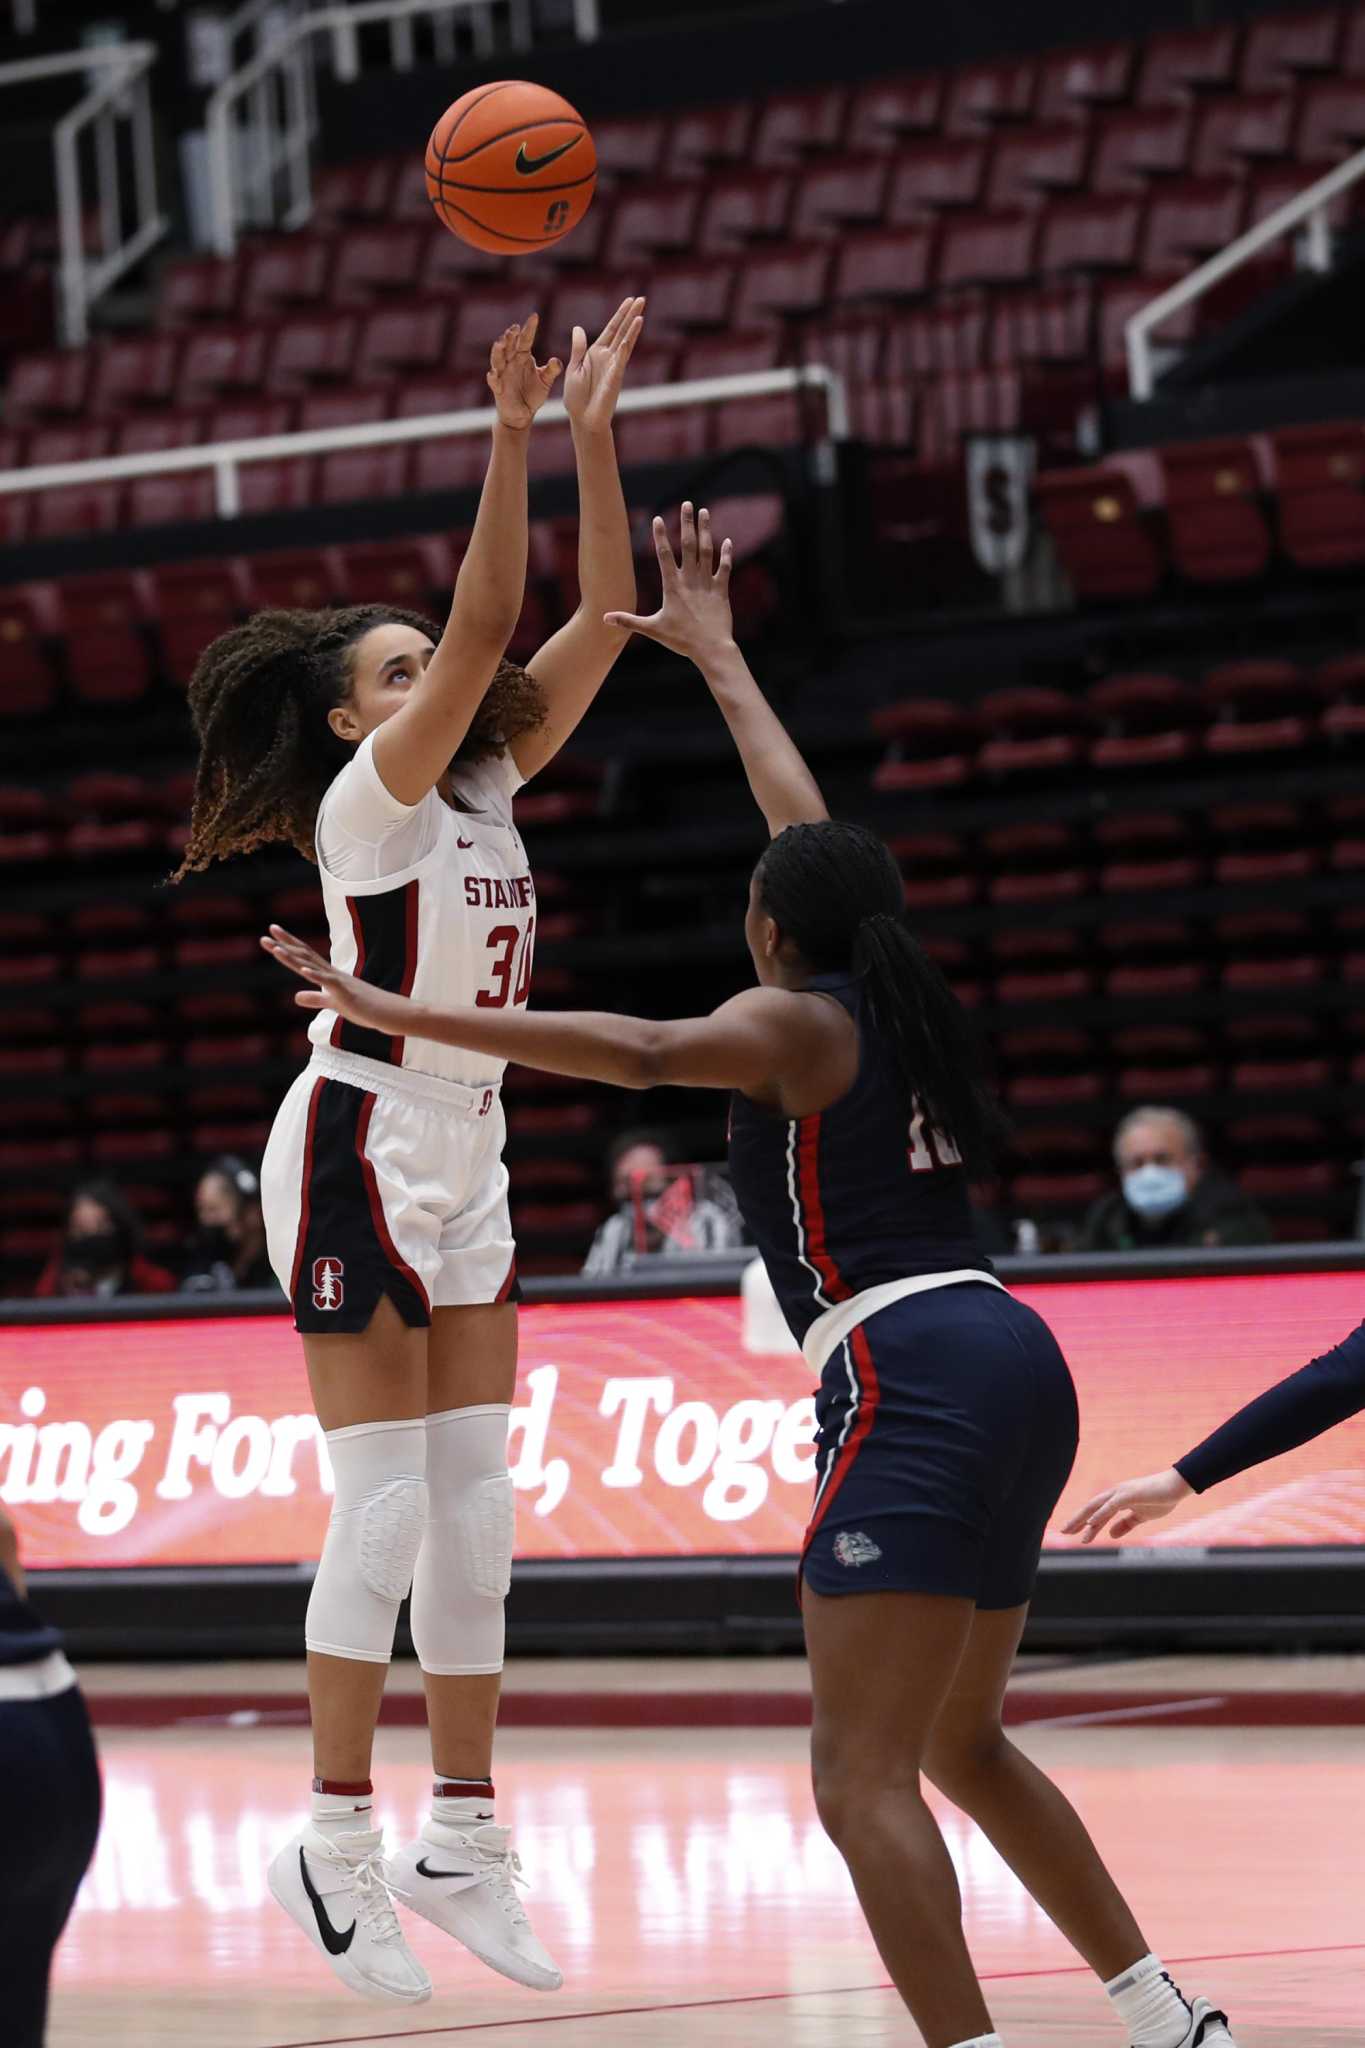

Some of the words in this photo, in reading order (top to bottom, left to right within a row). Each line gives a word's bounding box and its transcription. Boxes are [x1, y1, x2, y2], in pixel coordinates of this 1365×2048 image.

[464, 876, 533, 908] STANF
[475, 916, 534, 1008] 30
[312, 1256, 344, 1310] S
[0, 1387, 154, 1536] ing
[598, 1376, 819, 1522] Toge
